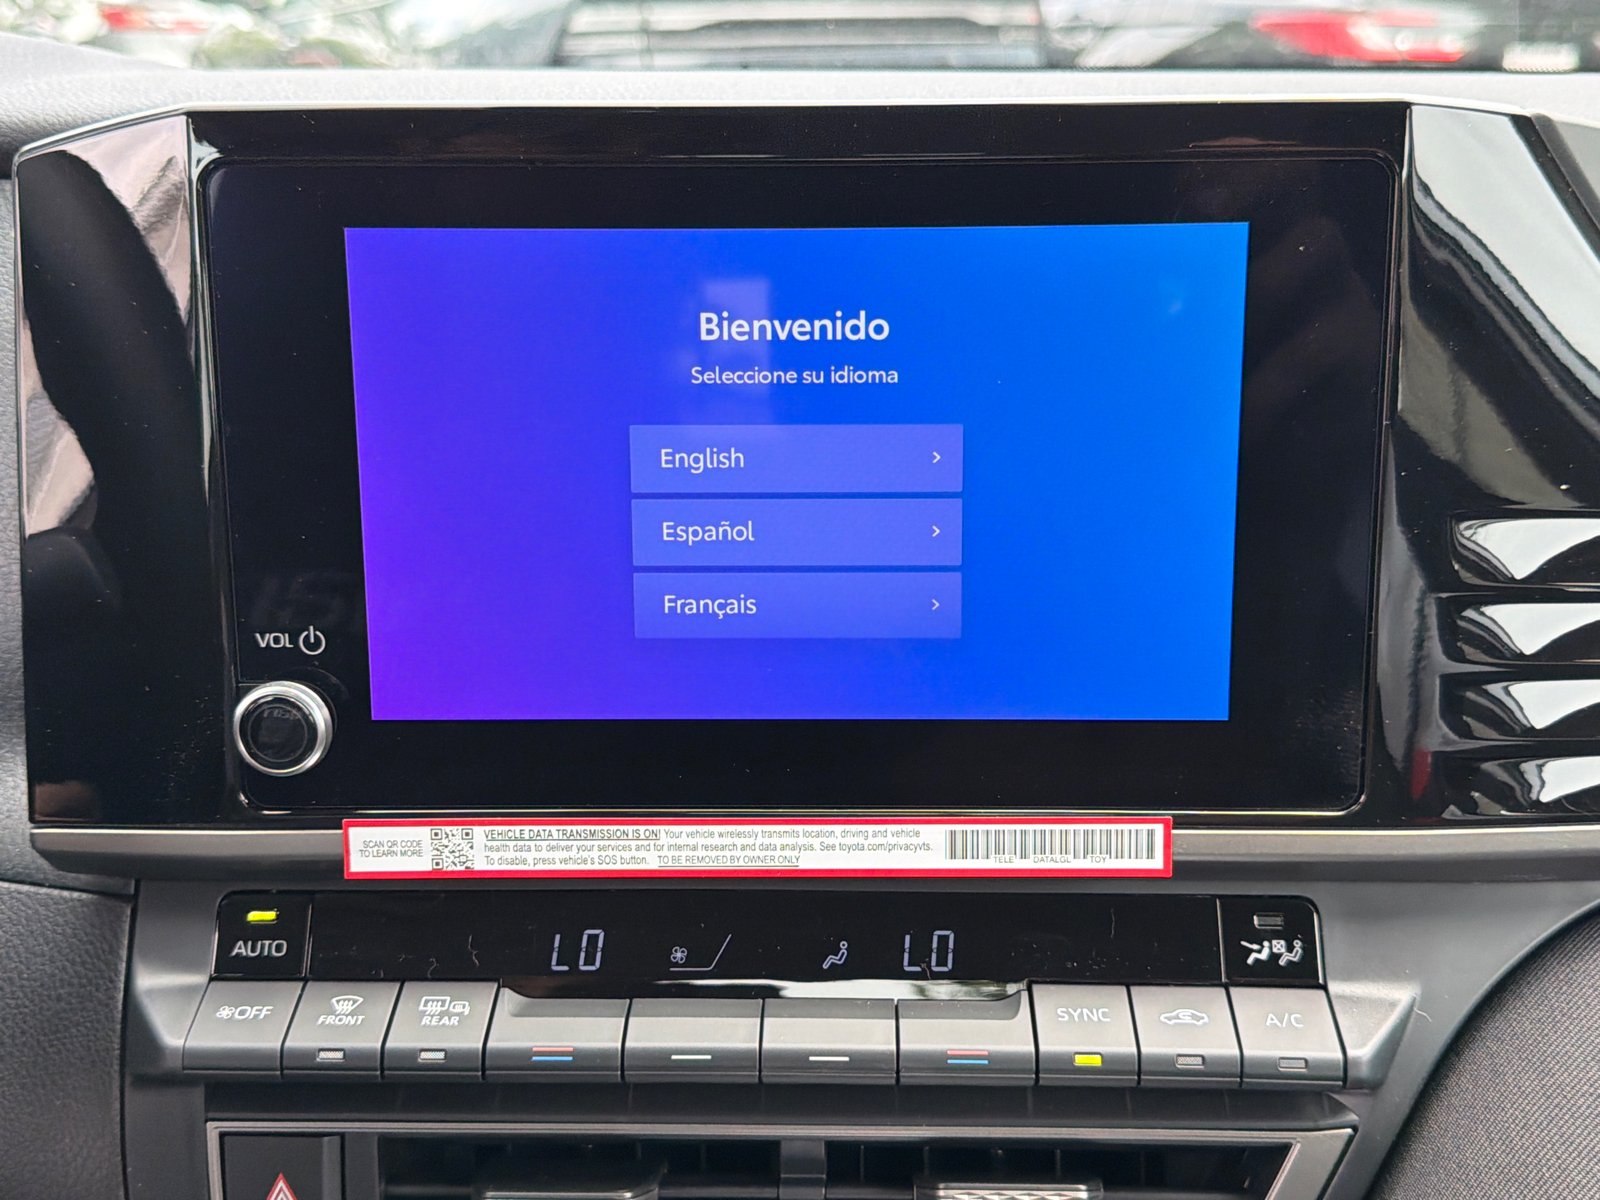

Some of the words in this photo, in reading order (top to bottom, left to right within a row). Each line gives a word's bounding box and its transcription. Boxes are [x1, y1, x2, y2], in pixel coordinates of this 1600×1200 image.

[699, 310, 890, 341] Bienvenido
[691, 366, 798, 384] Seleccione
[802, 369, 825, 384] su
[830, 366, 899, 384] idioma
[660, 447, 745, 474] English
[662, 520, 755, 545] Español
[663, 594, 757, 619] Français
[255, 633, 294, 648] VOL
[484, 829, 525, 840] VEHICLE
[528, 829, 554, 840] DATA
[555, 829, 629, 840] TRANSMISSION
[632, 829, 641, 839] IS
[643, 829, 661, 839] ON!
[664, 829, 683, 839] Your
[685, 829, 715, 838] vehicle
[717, 829, 759, 840] wirelessly
[761, 829, 800, 838] transmits
[802, 829, 838, 840] location,
[840, 828, 869, 840] driving
[871, 828, 888, 838] and
[890, 828, 920, 838] vehicle
[363, 840, 385, 849] SCAN
[386, 840, 399, 849] QR
[400, 840, 423, 849] CODE
[484, 843, 510, 852] health
[512, 843, 532, 852] data
[534, 844, 543, 852] to
[545, 843, 574, 852] deliver
[576, 845, 595, 854] your
[596, 843, 633, 852] services
[634, 842, 651, 852] and
[653, 842, 664, 852] for
[667, 842, 698, 852] internal
[701, 842, 738, 852] research
[740, 842, 756, 852] and
[758, 842, 778, 852] data
[779, 842, 817, 853] analysis.
[819, 841, 836, 851] See
[838, 841, 933, 854] toyota.com/privacyvts.
[359, 849, 371, 858] TO
[372, 849, 398, 858] LEARN
[400, 849, 424, 858] MORE
[484, 856, 495, 866] To
[497, 856, 530, 867] disable,
[533, 857, 556, 867] press
[558, 855, 595, 865] vehicle's
[597, 855, 618, 865] SOS
[620, 854, 649, 865] button.
[657, 856, 670, 864] TO
[671, 855, 683, 864] BE
[685, 855, 728, 864] REMOVED
[730, 855, 742, 864] BY
[742, 855, 776, 864] OWNER
[777, 855, 800, 864] ONLY
[230, 939, 288, 958] AUTO
[234, 1006, 273, 1020] OFF
[317, 1015, 365, 1026] FRONT
[1056, 1007, 1111, 1023] SYNC
[1265, 1013, 1304, 1028] A/C
[420, 1015, 460, 1027] REAR
